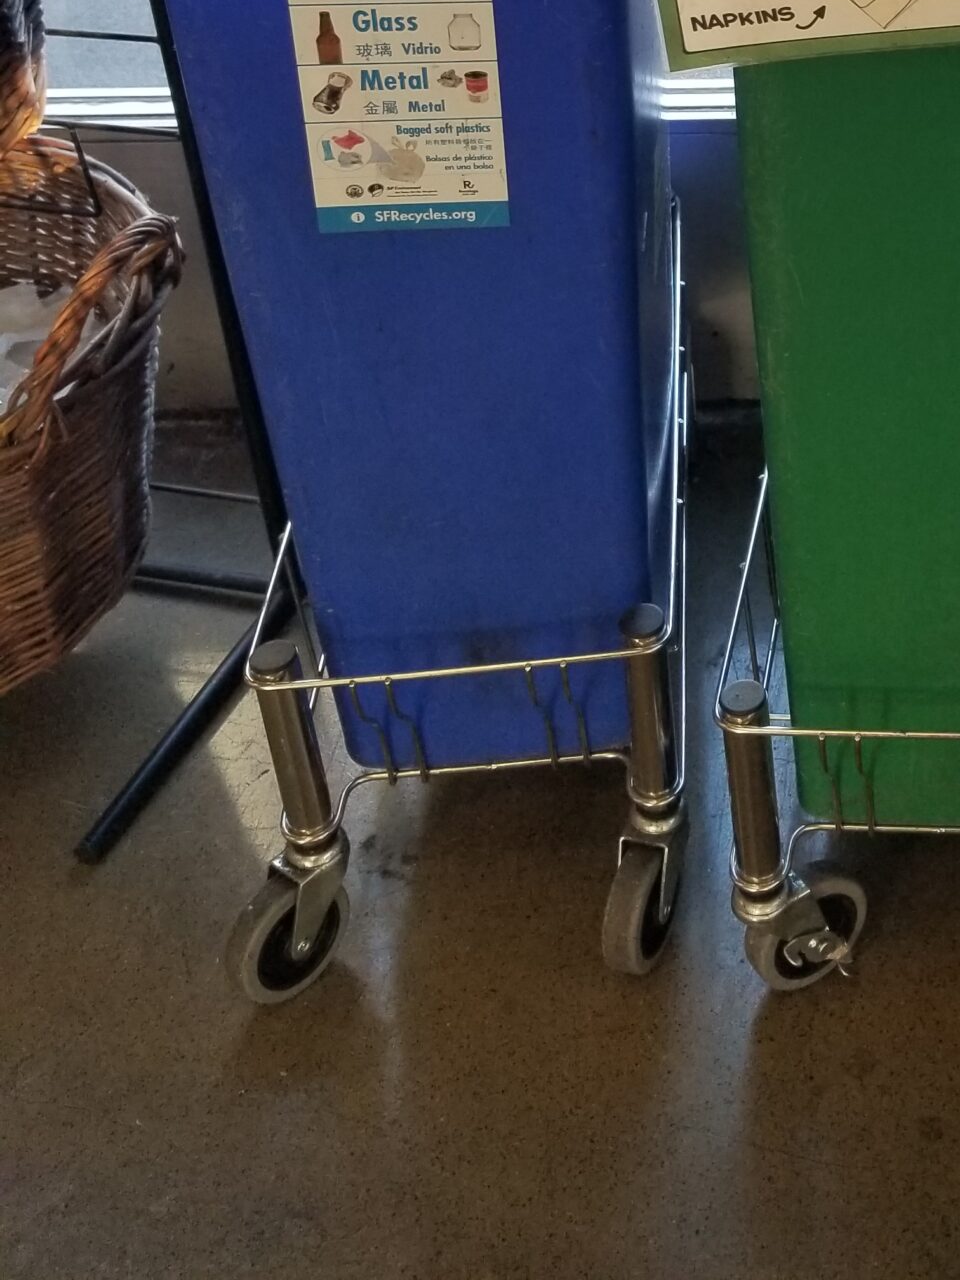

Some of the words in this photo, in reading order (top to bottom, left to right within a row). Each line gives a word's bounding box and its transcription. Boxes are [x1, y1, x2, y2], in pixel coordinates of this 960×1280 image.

[352, 8, 418, 33] Glass
[690, 6, 795, 32] NAPKINS
[355, 42, 393, 58] 玻璃
[401, 42, 442, 55] Vidrio
[360, 66, 429, 91] Metal
[362, 100, 399, 116] 金屬
[407, 100, 446, 114] Metal
[396, 123, 432, 138] Bagged
[434, 122, 453, 134] soft
[455, 122, 491, 136] plastics
[452, 154, 462, 162] de
[374, 208, 477, 223] SFRecycles.org
